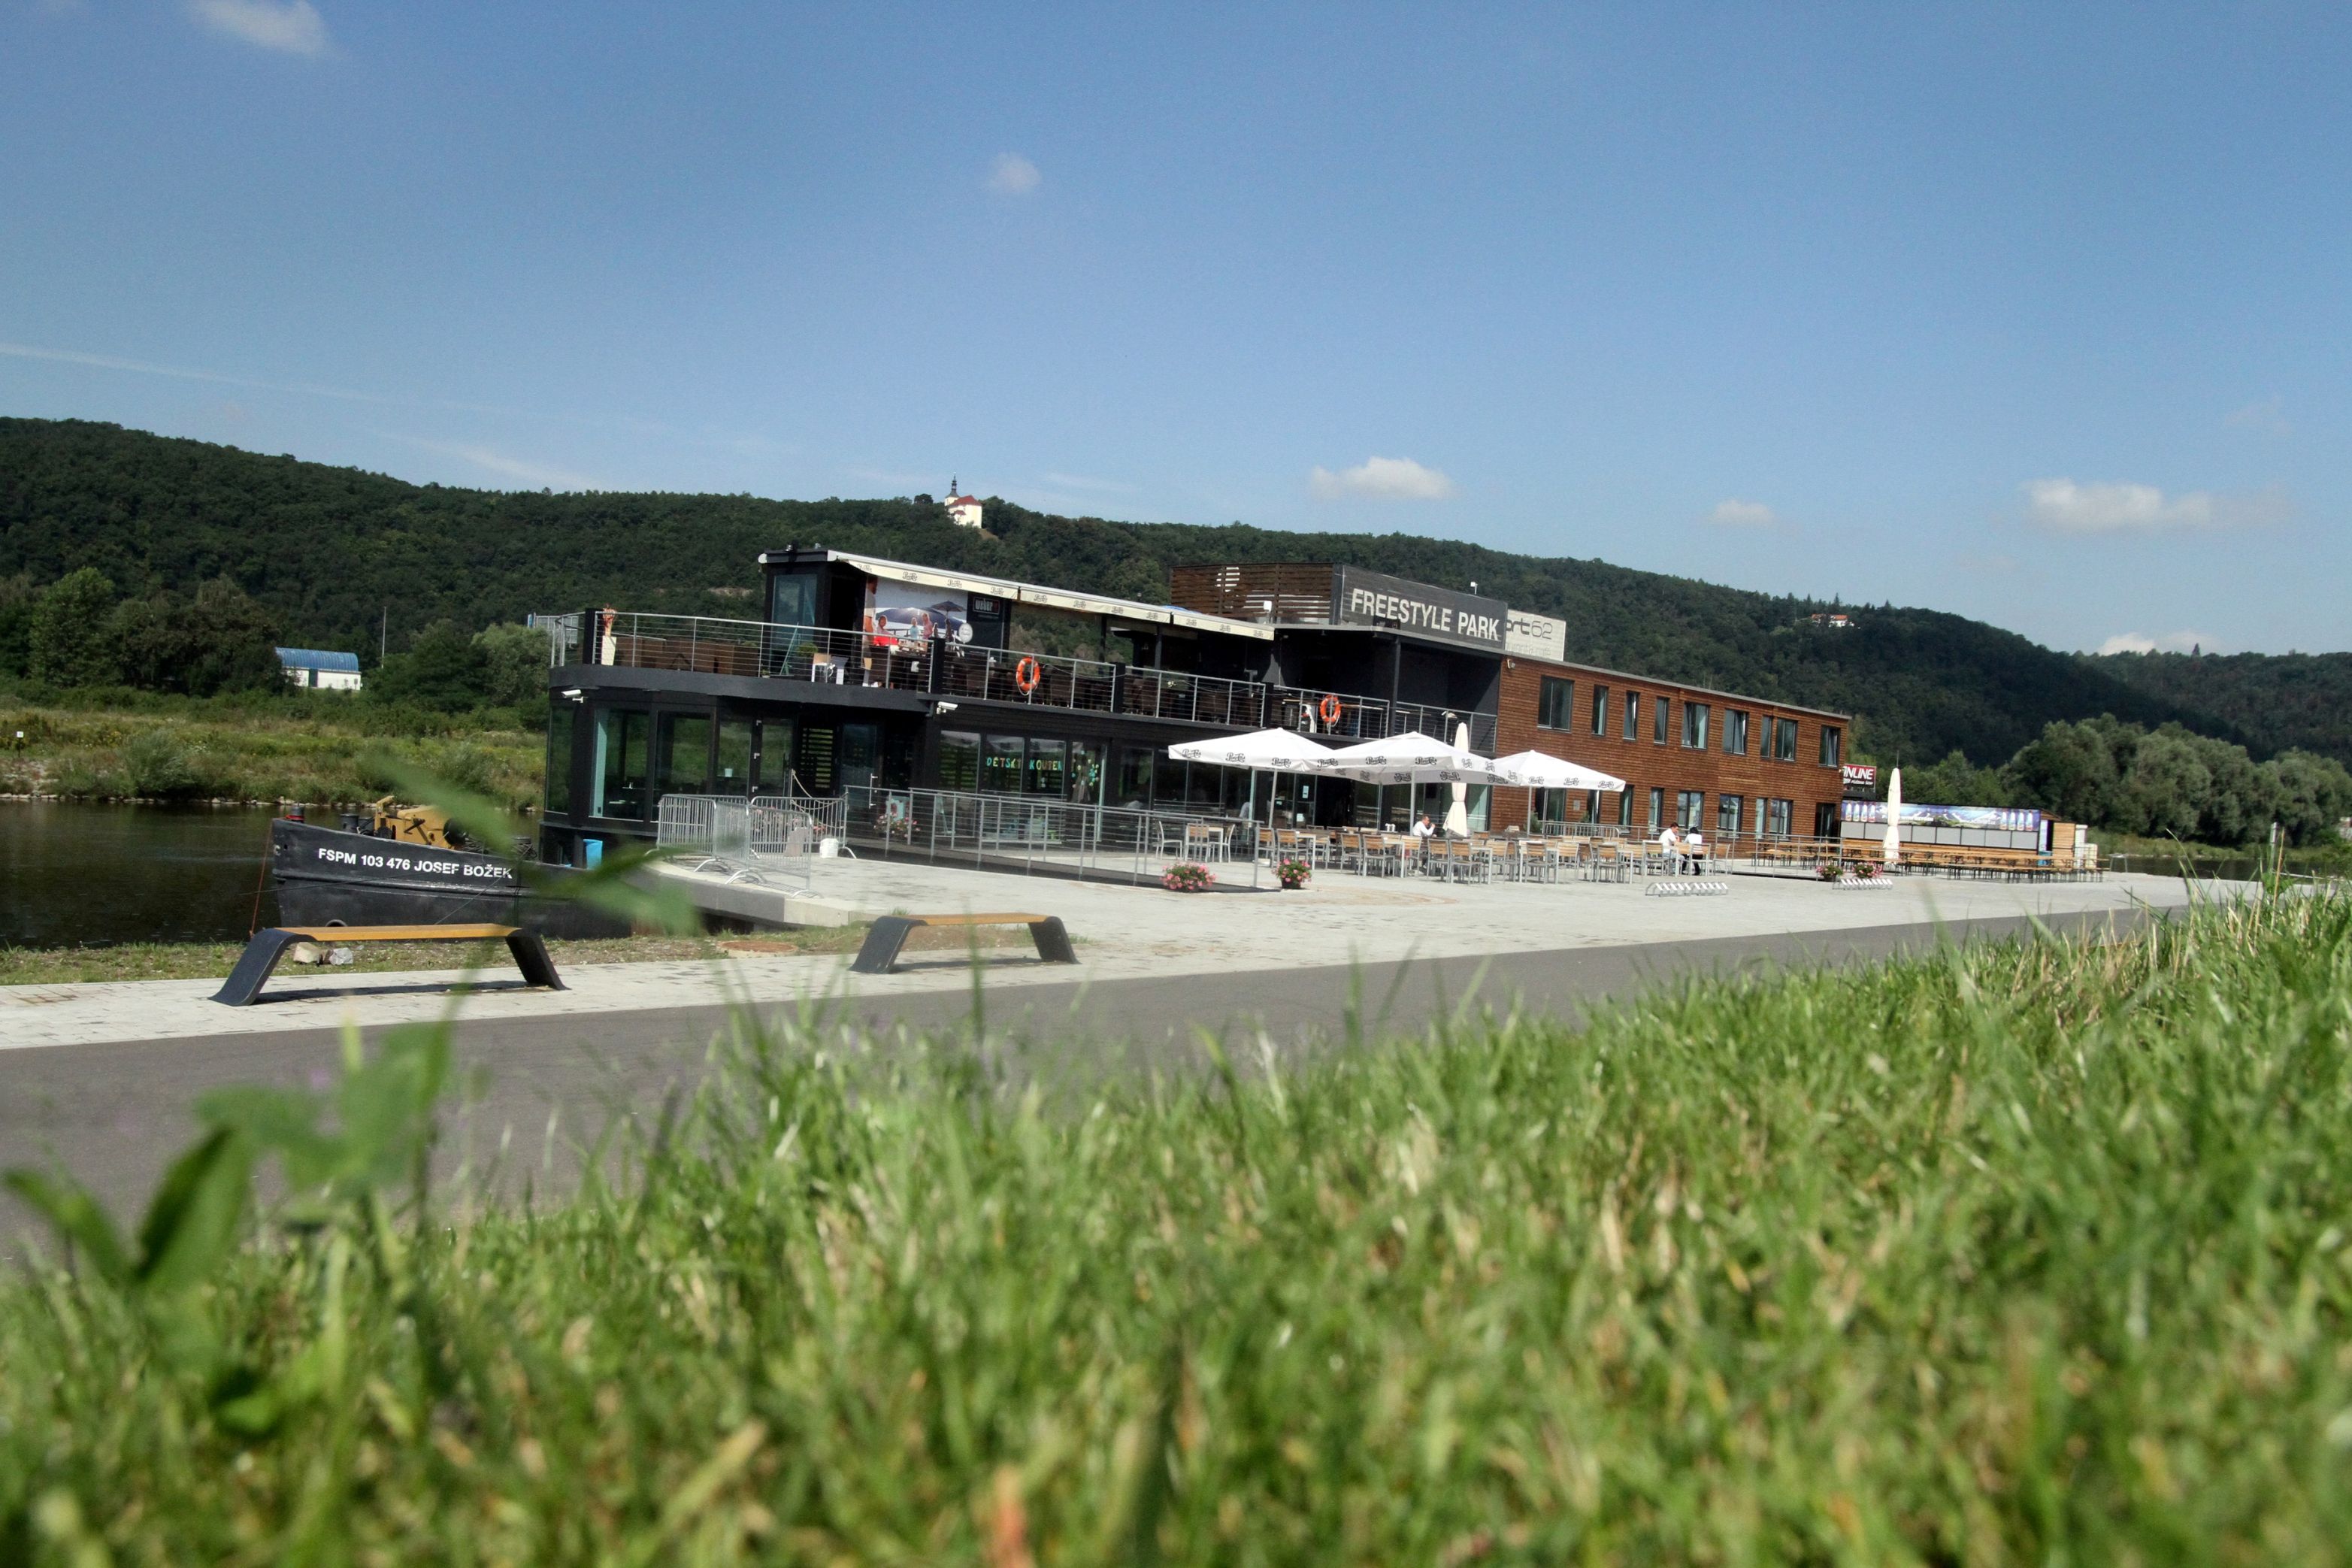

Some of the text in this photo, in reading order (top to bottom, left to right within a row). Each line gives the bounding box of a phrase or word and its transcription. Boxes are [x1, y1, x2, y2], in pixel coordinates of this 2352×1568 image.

[1351, 588, 1502, 641] FREESTYLE PARK
[319, 849, 513, 879] FSPM 103 476 JOSEF BOŽEK
